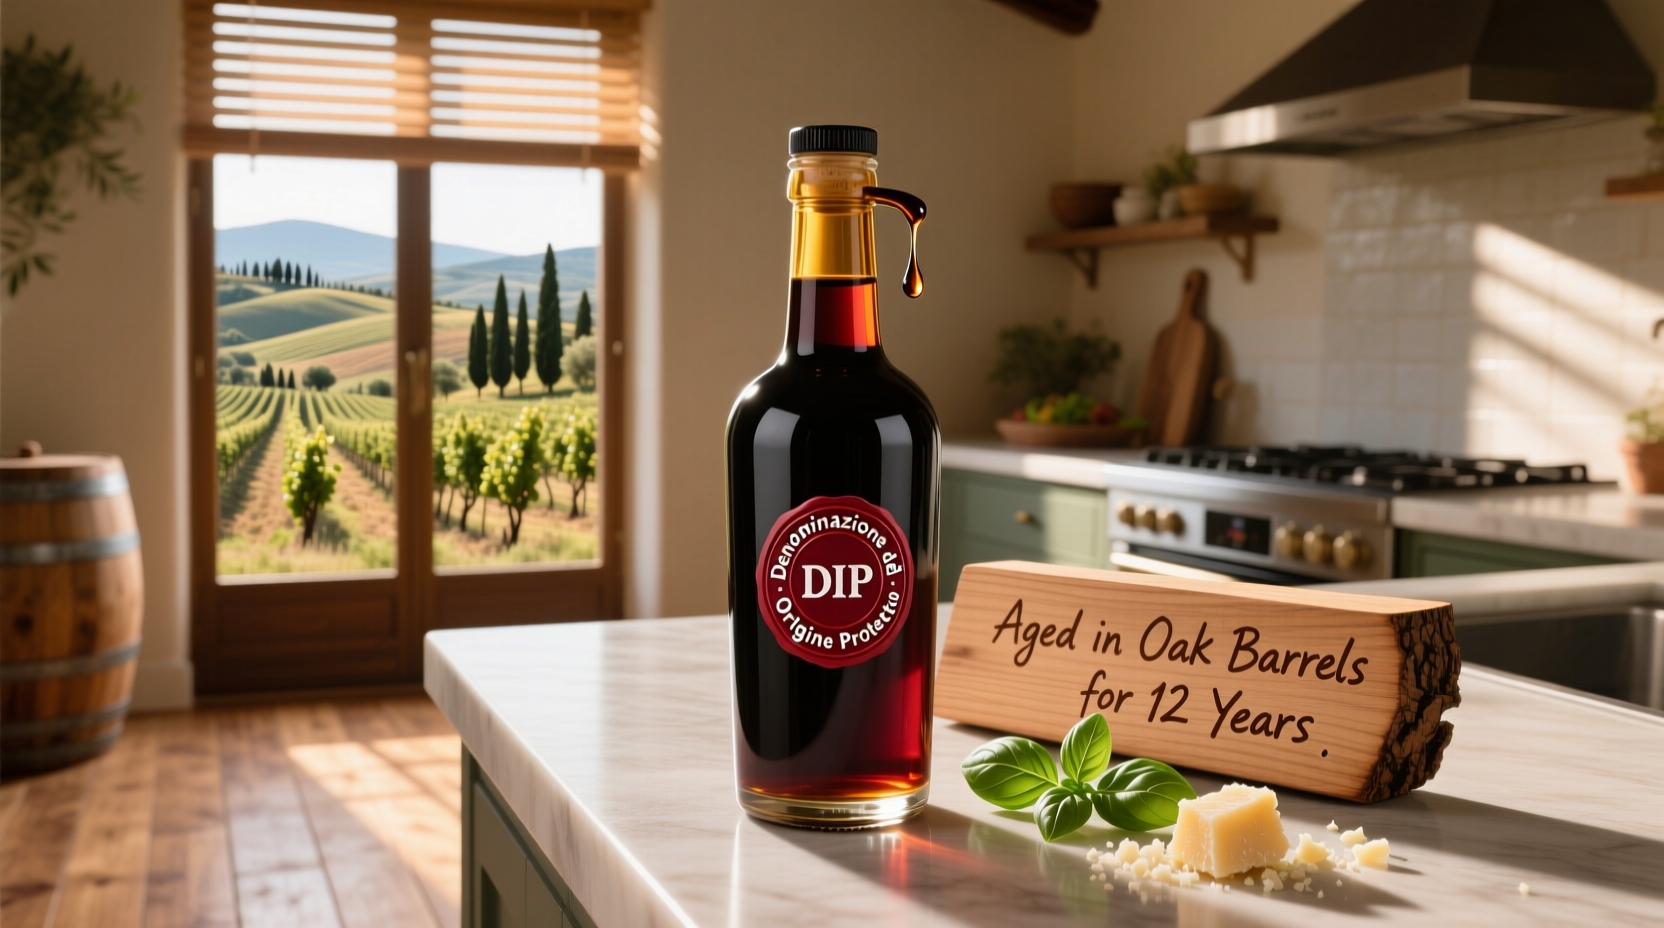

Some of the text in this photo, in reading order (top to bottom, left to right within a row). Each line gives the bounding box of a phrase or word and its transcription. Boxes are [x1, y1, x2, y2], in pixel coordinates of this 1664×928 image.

[801, 564, 874, 599] DIP
[992, 598, 1369, 686] Aged in Oak Barrels
[1079, 669, 1134, 719] for
[1147, 681, 1190, 724] 12
